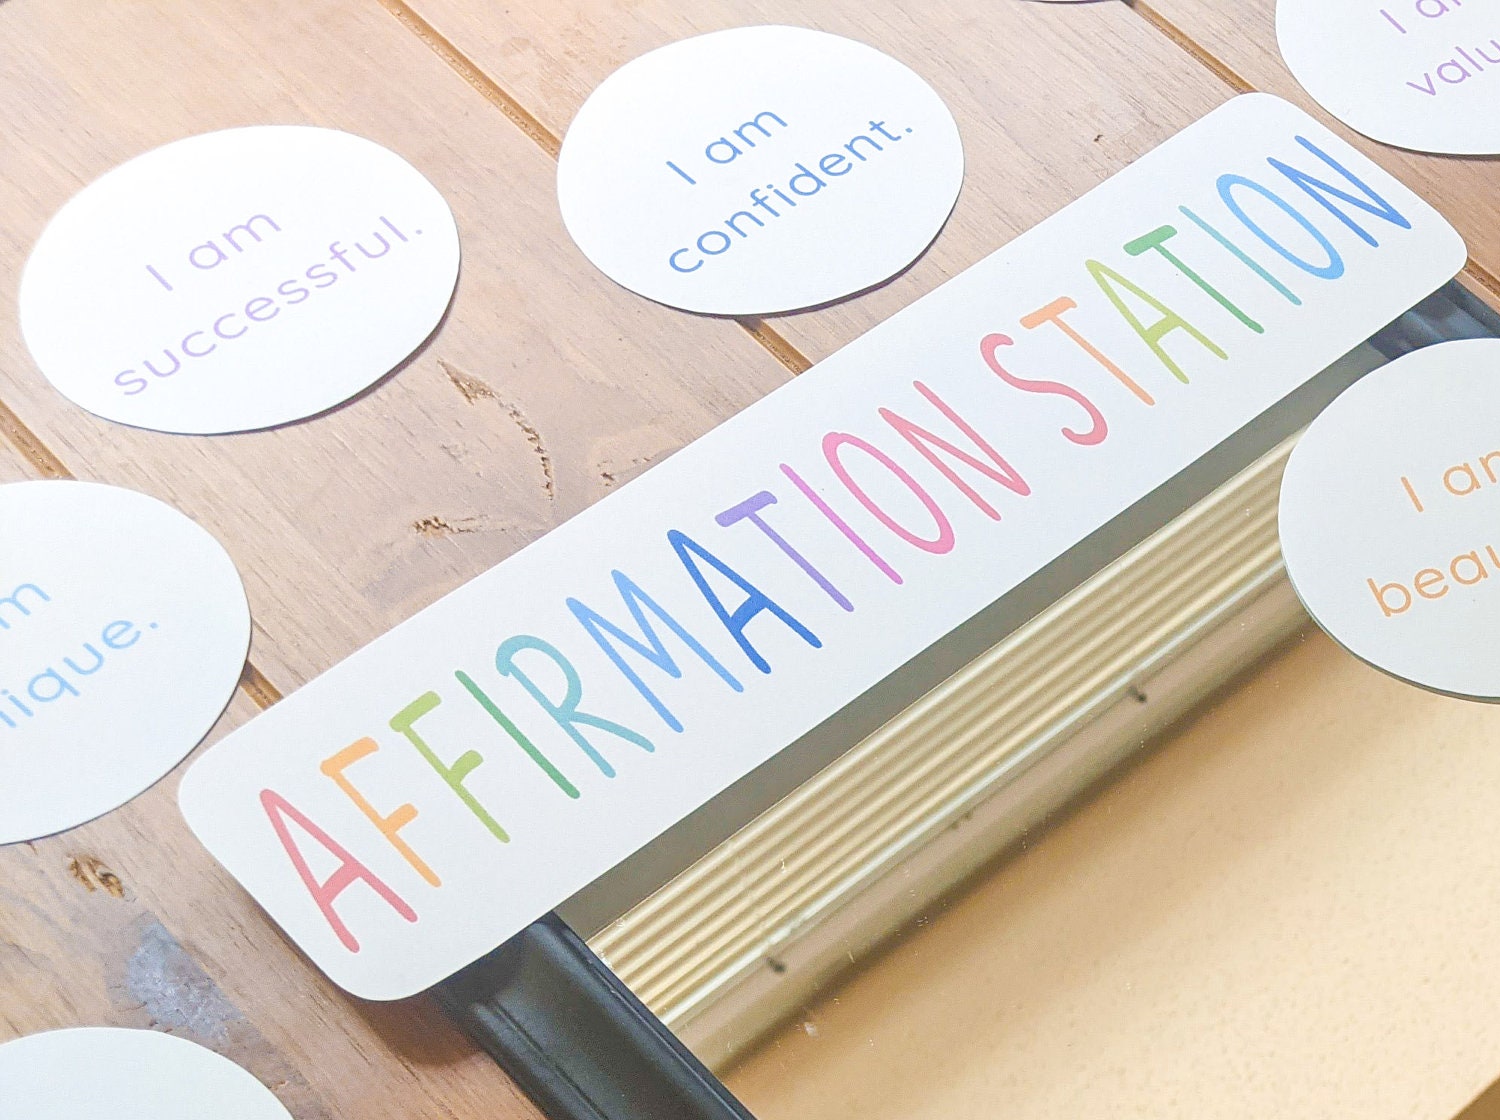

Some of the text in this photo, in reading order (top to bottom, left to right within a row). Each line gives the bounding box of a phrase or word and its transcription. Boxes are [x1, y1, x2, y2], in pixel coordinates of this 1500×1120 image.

[1379, 0, 1462, 35] I a
[665, 105, 789, 186] I am
[668, 116, 914, 275] confident.
[144, 207, 283, 293] I am
[112, 214, 424, 398] successful.
[1398, 475, 1426, 513] I
[258, 134, 1413, 955] AFFIRMATION STATION
[0, 619, 160, 729] ique.
